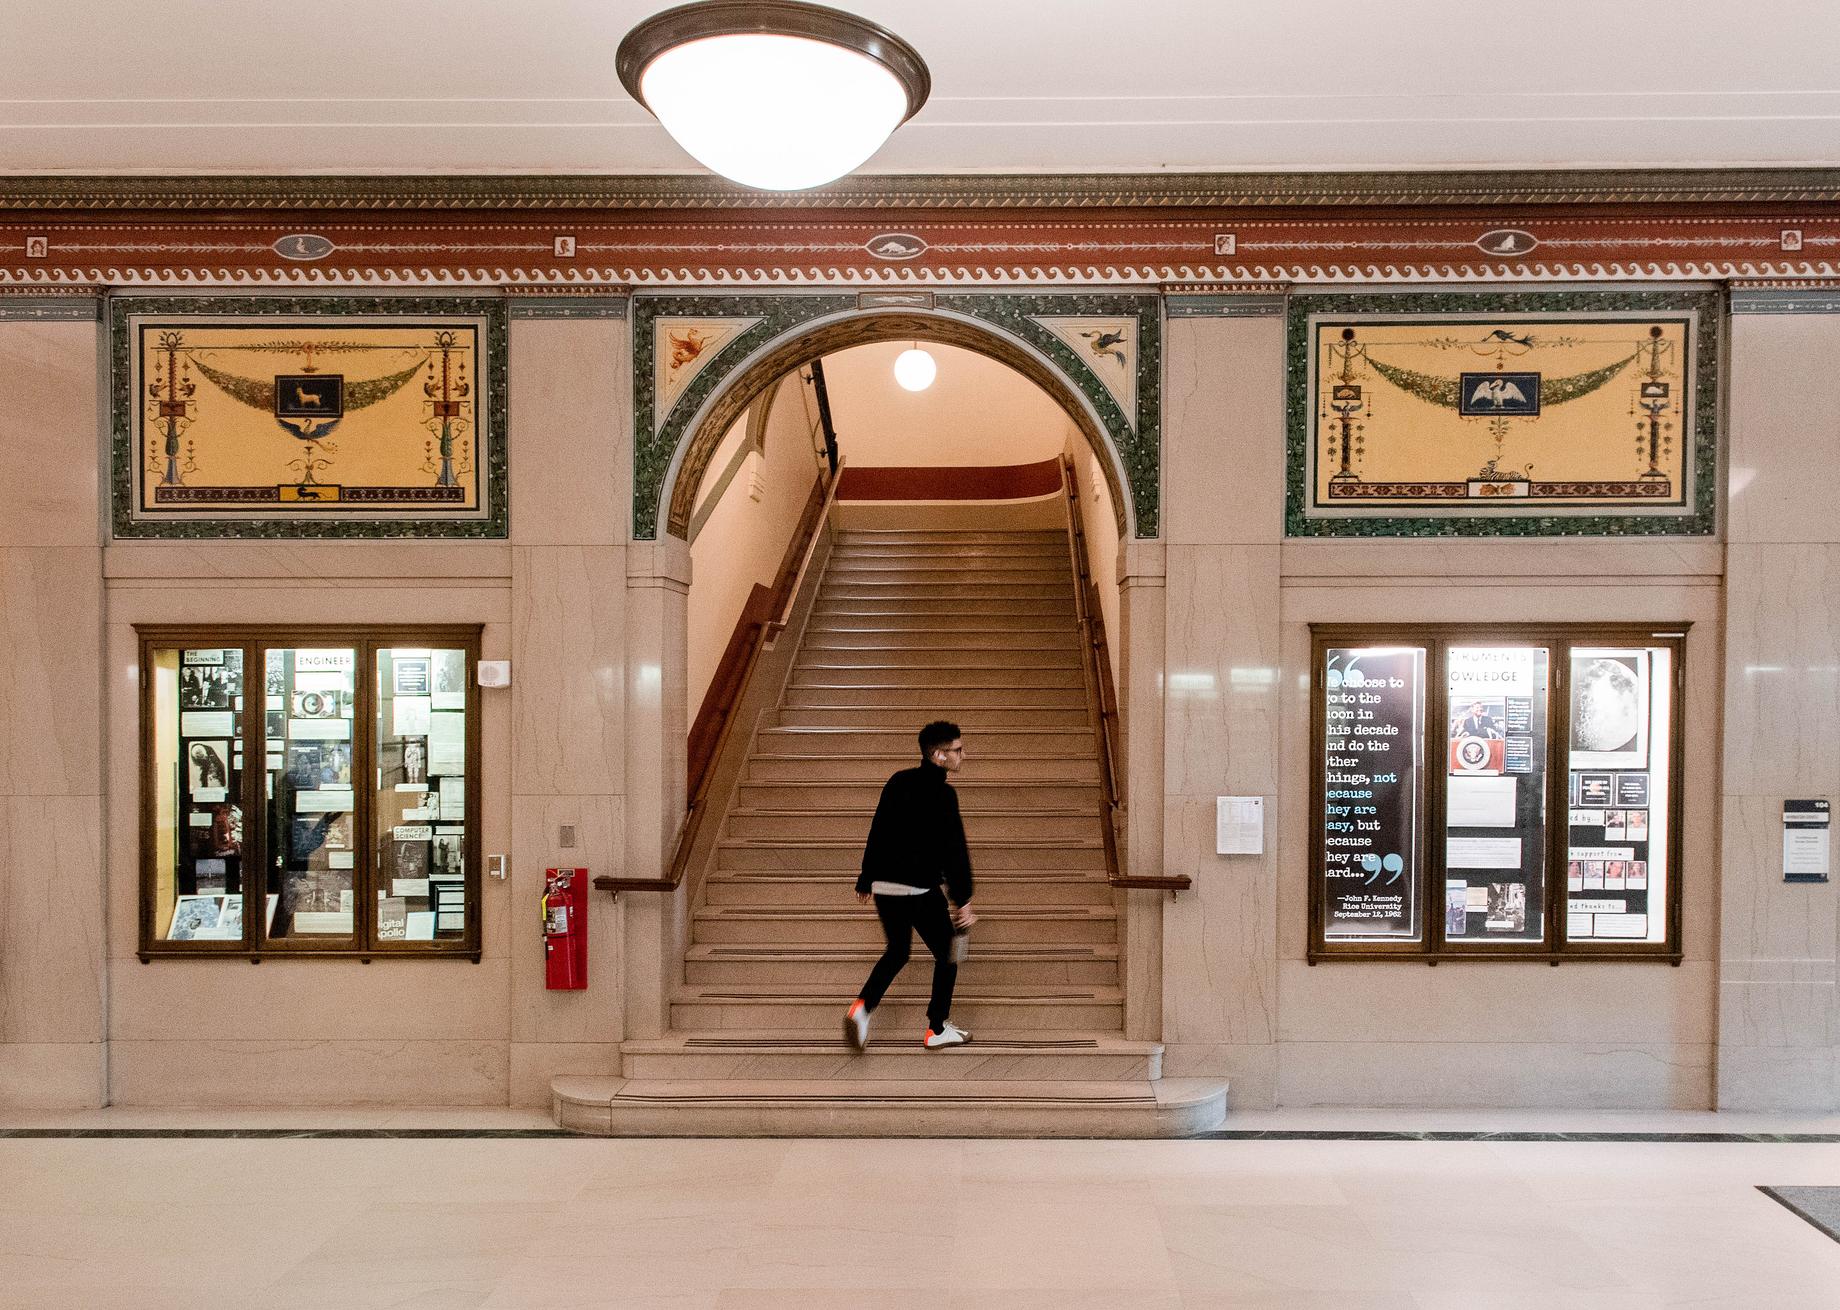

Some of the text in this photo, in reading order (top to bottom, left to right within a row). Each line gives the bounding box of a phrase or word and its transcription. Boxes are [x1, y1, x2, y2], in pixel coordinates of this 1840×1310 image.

[1450, 671, 1518, 682] OWLEDGE
[1342, 677, 1387, 688] choose
[1389, 677, 1404, 688] to
[1341, 693, 1356, 703] to
[1359, 693, 1382, 703] the
[1357, 709, 1374, 719] in
[1327, 724, 1399, 735] his decade
[1348, 740, 1364, 751] do
[1367, 740, 1390, 751] the
[1327, 772, 1397, 786] hings, not
[1327, 804, 1377, 817] hey are
[1327, 820, 1381, 833] asy, but
[1326, 837, 1372, 846] ecause
[1326, 851, 1377, 864] hey are
[1373, 895, 1403, 903] Kennedy
[1361, 903, 1402, 911] University
[1334, 911, 1372, 919] September
[1372, 911, 1383, 919] 12,
